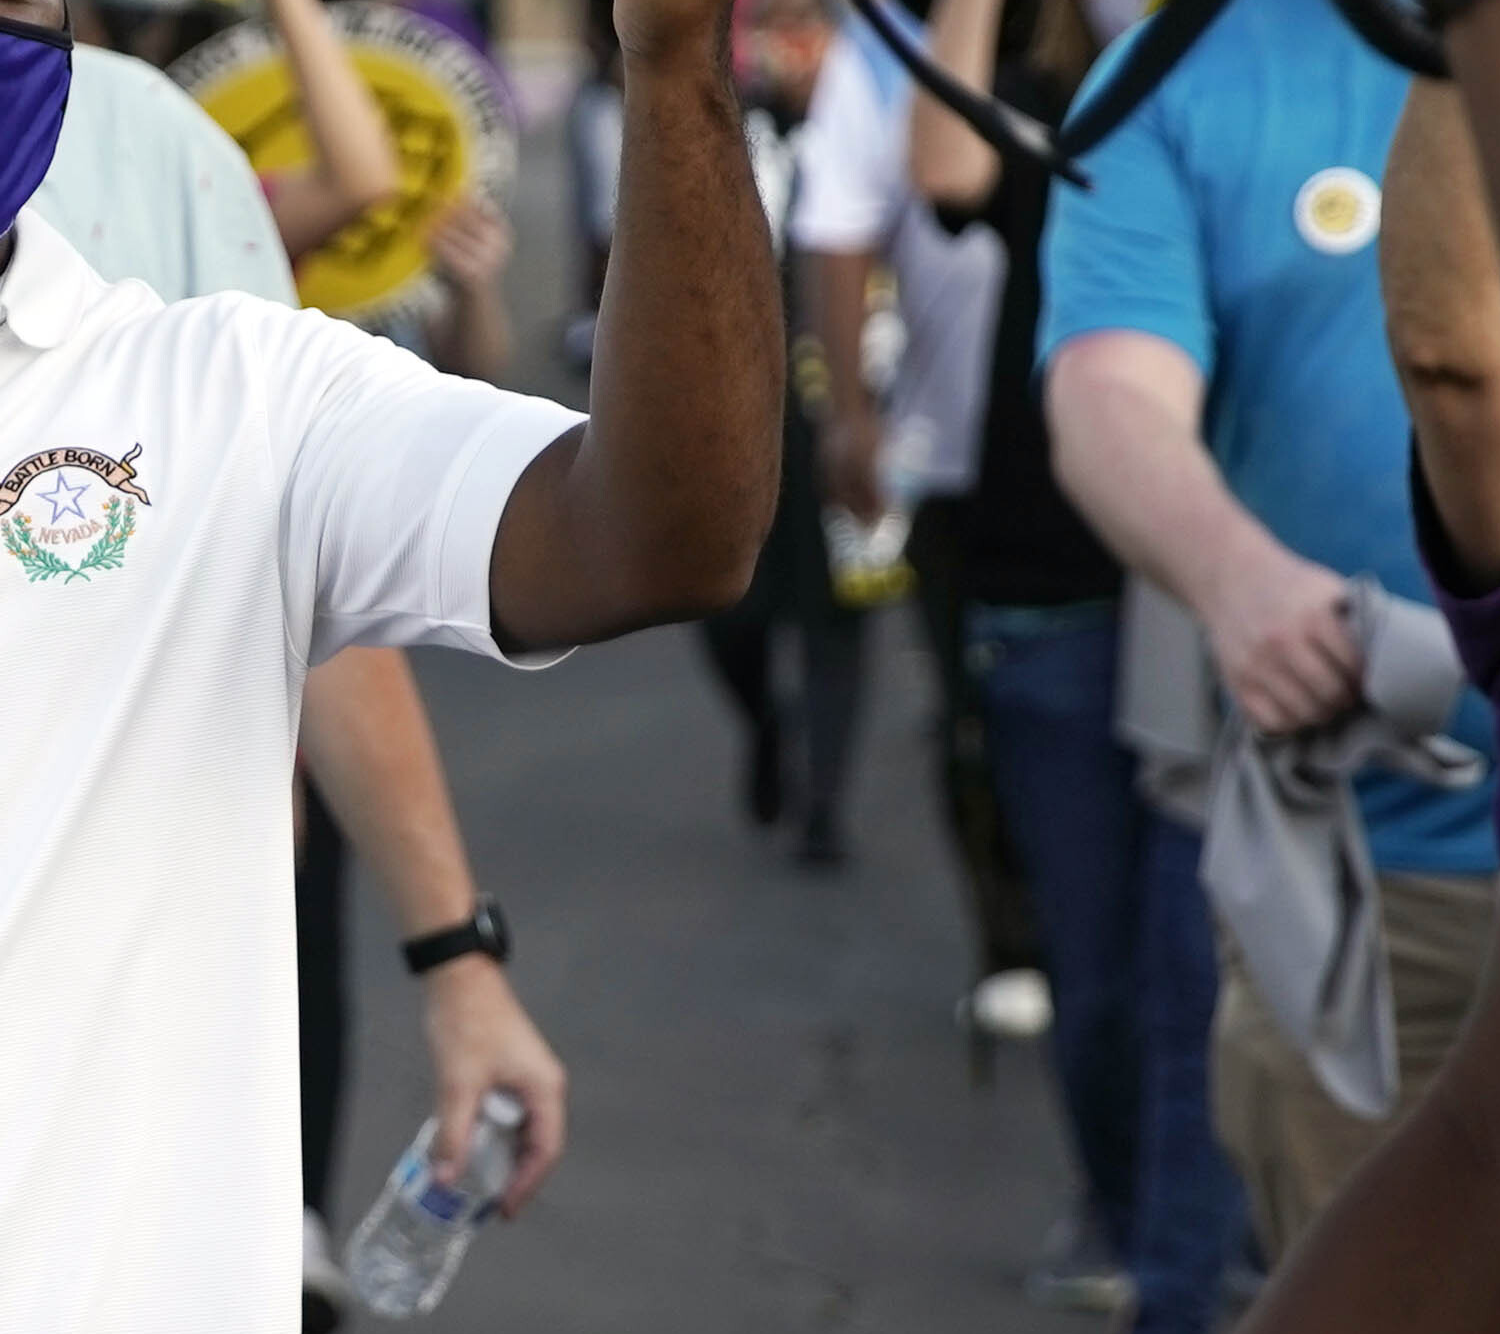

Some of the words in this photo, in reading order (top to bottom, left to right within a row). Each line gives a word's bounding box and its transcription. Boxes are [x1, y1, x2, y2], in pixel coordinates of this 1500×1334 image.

[4, 452, 59, 493] BATTLE
[64, 449, 117, 478] BORN
[37, 518, 102, 545] NEVADA
